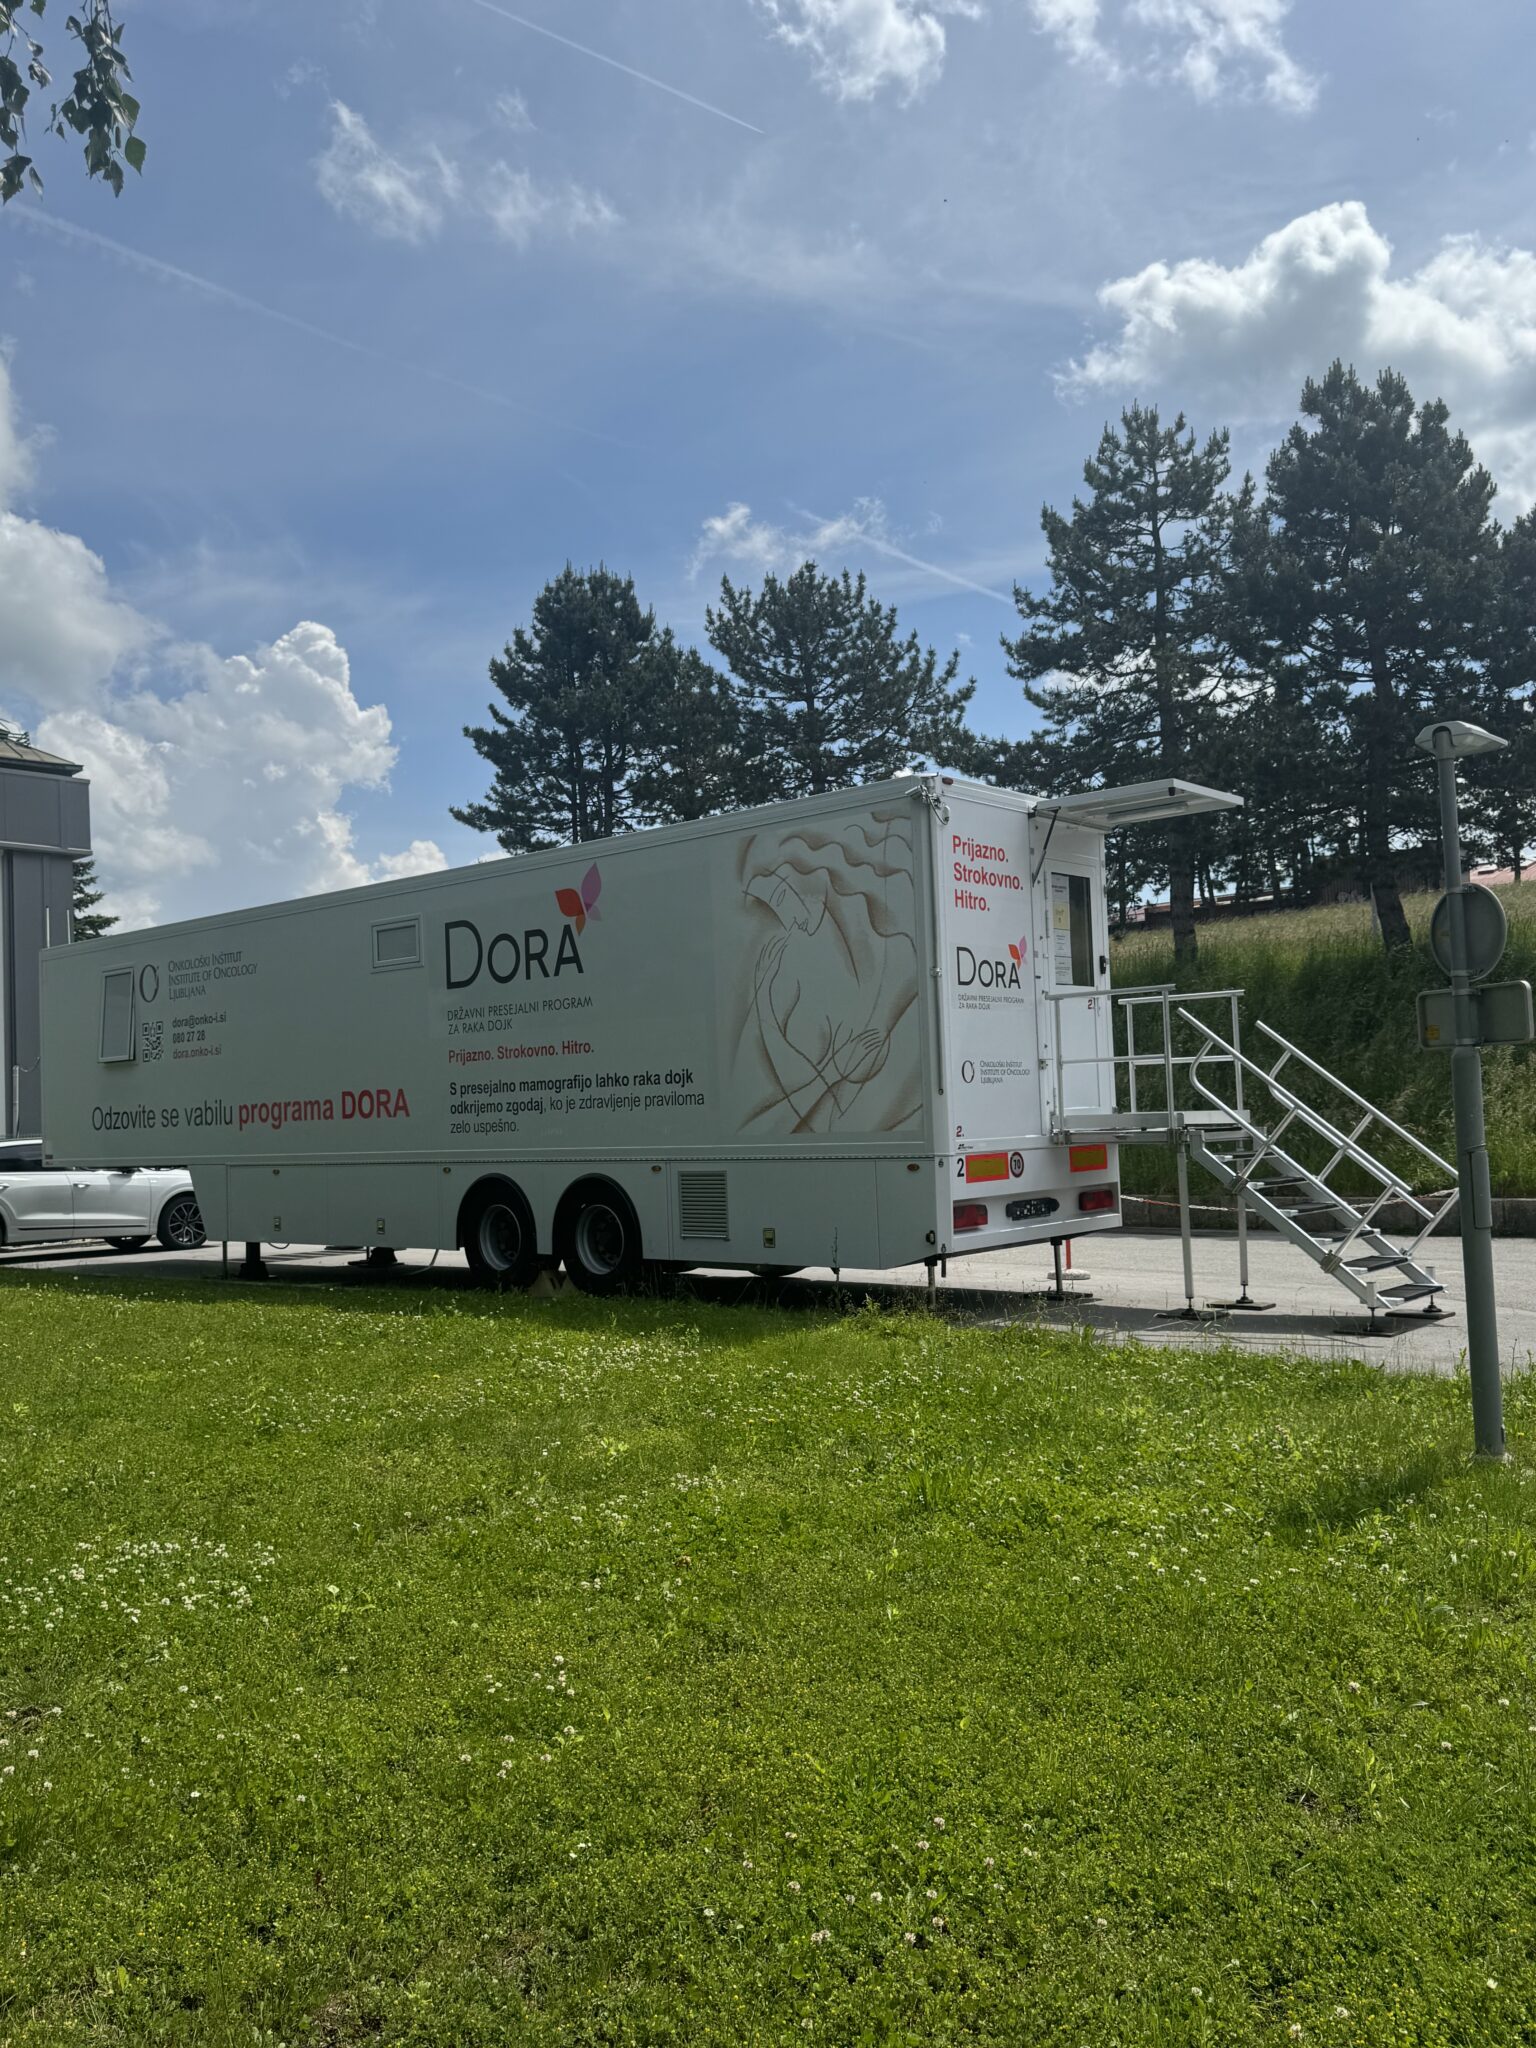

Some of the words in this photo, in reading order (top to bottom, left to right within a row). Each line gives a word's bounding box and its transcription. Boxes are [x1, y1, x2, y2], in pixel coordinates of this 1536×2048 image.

[953, 835, 1008, 862] Prijazno.
[953, 862, 1023, 890] Strokovno.
[955, 889, 990, 911] Hitro.
[445, 920, 584, 989] DORA
[169, 972, 200, 986] INSTITUTE
[202, 969, 212, 981] OF
[213, 963, 258, 979] ONCOLOGY
[957, 947, 1021, 989] DORA
[172, 1012, 226, 1028] dora@onko-i.si
[448, 1006, 484, 1021] DRŽAVNI
[488, 1002, 539, 1016] PRESEJALNI
[543, 996, 592, 1011] PROGRAM
[173, 1032, 185, 1044] 080
[187, 1032, 194, 1042] 27
[448, 1022, 459, 1035] ZA
[462, 1021, 485, 1034] RAKA
[488, 1019, 512, 1032] DOJK
[173, 1044, 221, 1059] dora.onko-i.si
[449, 1047, 494, 1065] Prijazno.
[497, 1044, 558, 1060] Strokovno.
[562, 1040, 594, 1055] Hitro.
[450, 1082, 457, 1096] S
[460, 1078, 516, 1098] presejalno
[520, 1074, 592, 1095] mamografijo
[596, 1072, 629, 1087] lahko
[633, 1072, 661, 1086] raka
[665, 1068, 694, 1087] dojk
[92, 1102, 156, 1131] Odzovite
[161, 1108, 179, 1128] se
[185, 1100, 234, 1127] vabilu
[239, 1097, 334, 1131] programa
[341, 1088, 410, 1120] DORA
[450, 1098, 503, 1116] odkrijemo
[506, 1096, 546, 1116] zgodaj,
[550, 1096, 563, 1111] ko
[566, 1095, 576, 1114] je
[579, 1092, 640, 1113] zdravljenje
[644, 1092, 704, 1113] praviloma
[450, 1120, 471, 1134] zelo
[474, 1118, 520, 1136] uspešno.
[957, 1158, 965, 1177] 2
